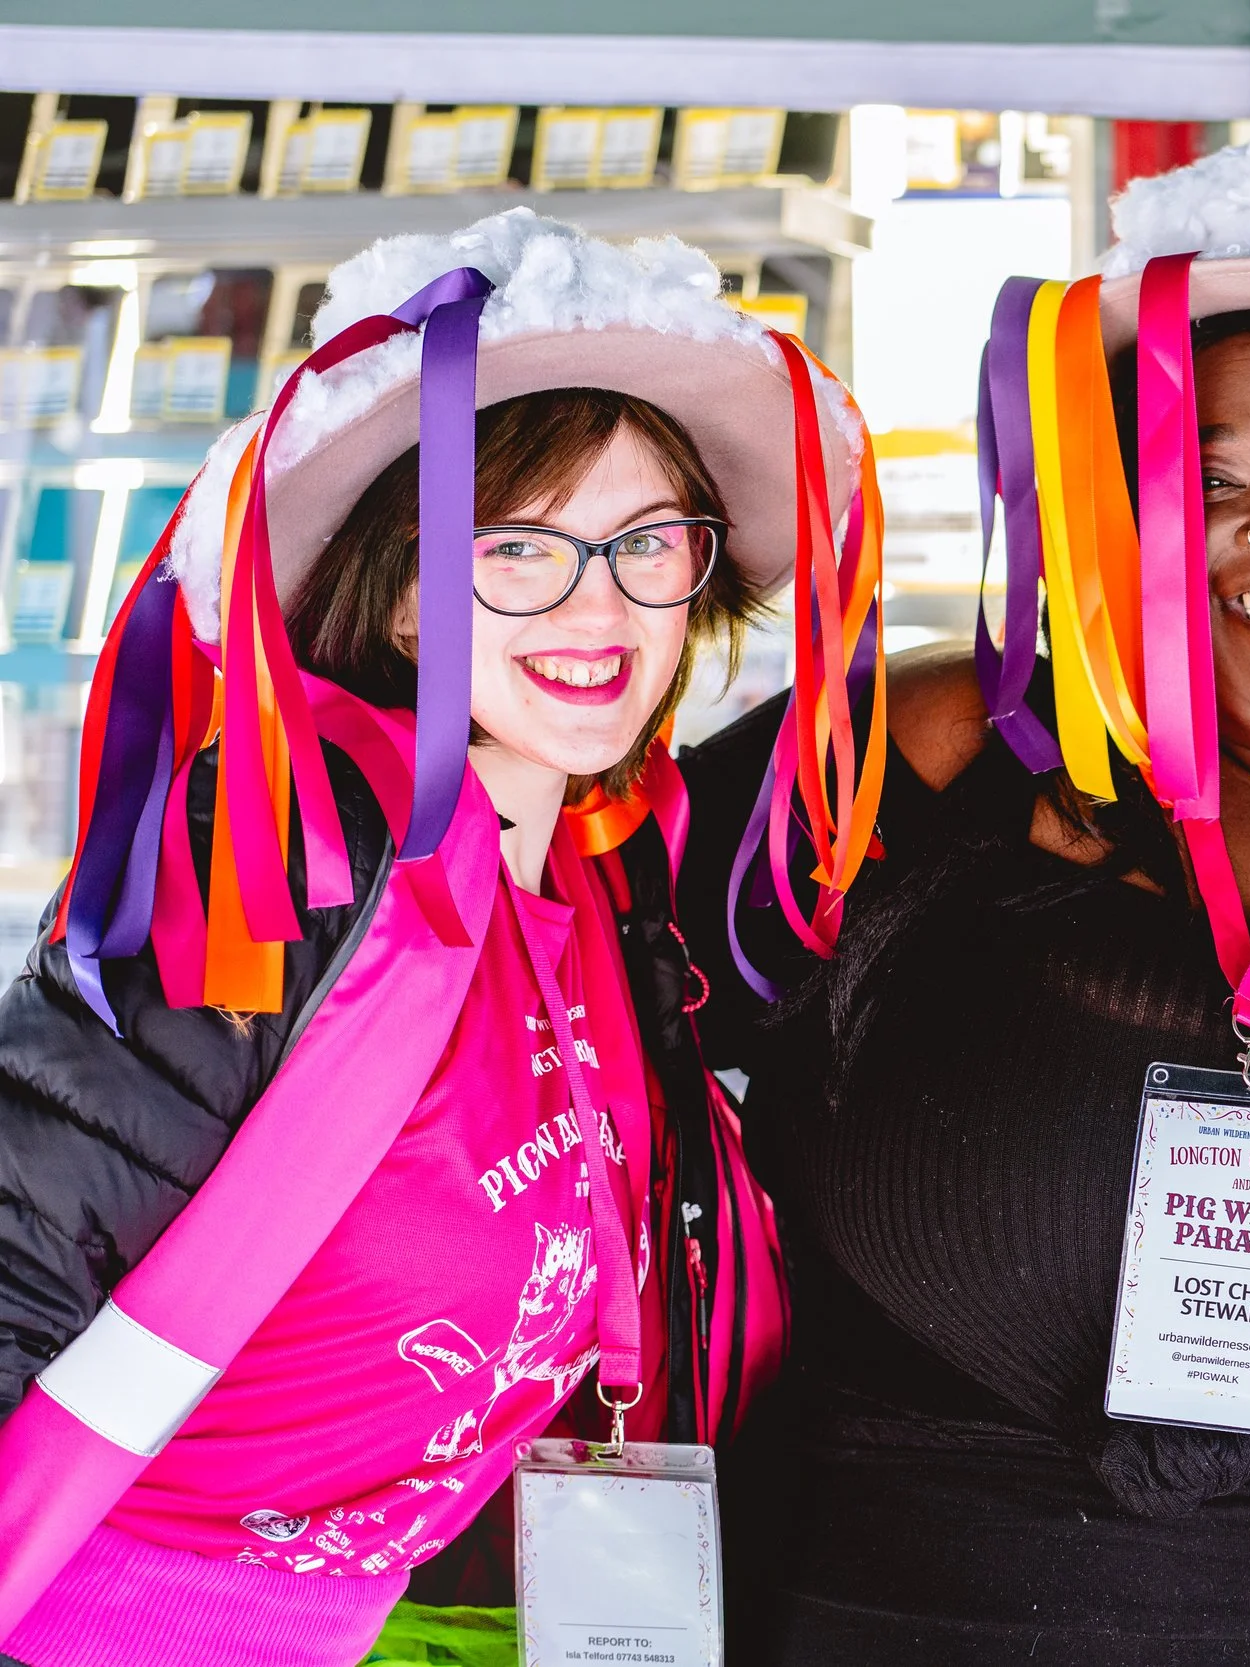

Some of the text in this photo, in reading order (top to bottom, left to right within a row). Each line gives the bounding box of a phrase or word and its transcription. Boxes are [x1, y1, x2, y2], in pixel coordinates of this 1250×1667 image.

[1198, 1125, 1221, 1136] URBAN
[1170, 1146, 1242, 1167] LONGTON
[1164, 1192, 1216, 1221] PIG
[1173, 1275, 1224, 1297] LOST
[411, 1343, 475, 1377] #BEMOREP
[1187, 1370, 1239, 1385] #PIGWALK
[588, 1636, 652, 1648] REPORT TO:
[565, 1651, 675, 1663] Isla Telford 07743 548313
